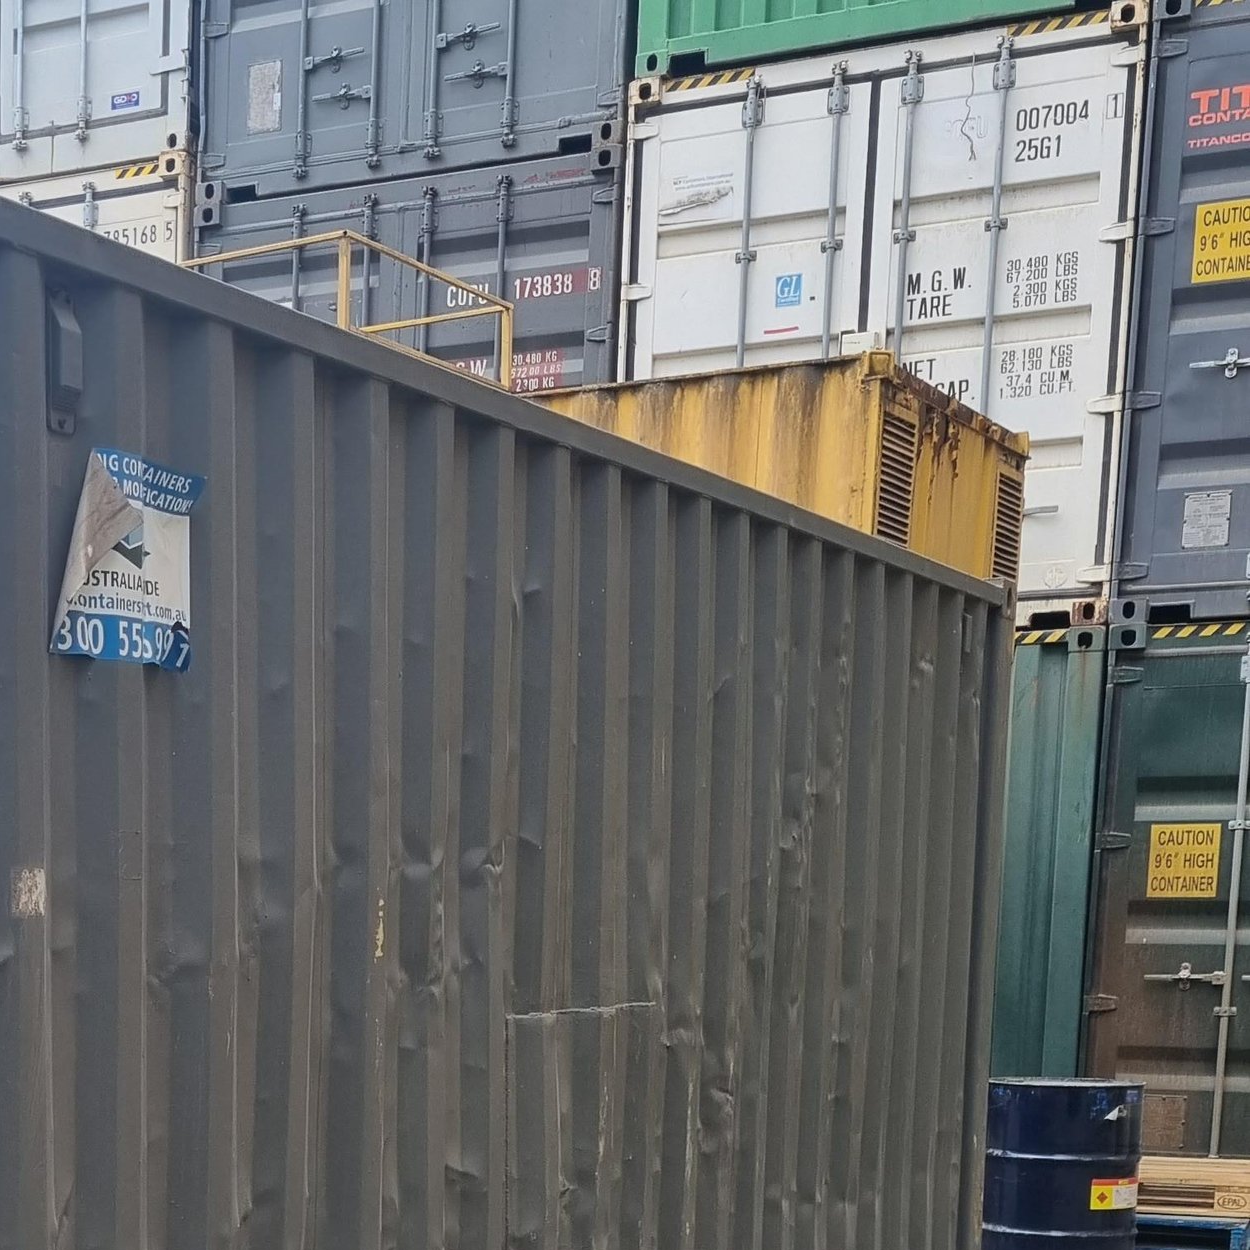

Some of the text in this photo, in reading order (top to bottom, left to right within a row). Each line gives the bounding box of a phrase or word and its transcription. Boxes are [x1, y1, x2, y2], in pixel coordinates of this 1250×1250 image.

[1015, 100, 1090, 132] 007004
[1014, 135, 1062, 163] 25G1
[165, 221, 173, 241] 5
[907, 251, 1079, 297] M.G.W. 30.480 KGS
[1006, 263, 1078, 284] 67.200 LBS
[514, 274, 573, 300] 173838
[590, 269, 599, 290] 8
[906, 277, 1078, 321] TARE 2.300 KGS
[1012, 290, 1077, 309] 5.070 LBS
[545, 351, 558, 364] KG
[1001, 347, 1043, 363] 28.180
[1050, 344, 1073, 358] KGS
[1000, 356, 1073, 374] 62.130 LBS
[542, 377, 555, 389] KG
[1006, 373, 1032, 388] 37.4
[999, 386, 1032, 400] 1.320
[1158, 830, 1214, 847] CAUTION
[1183, 852, 1215, 869] HIGH
[1150, 876, 1214, 892] CONTAINER
[1222, 1197, 1243, 1207] EPAL
